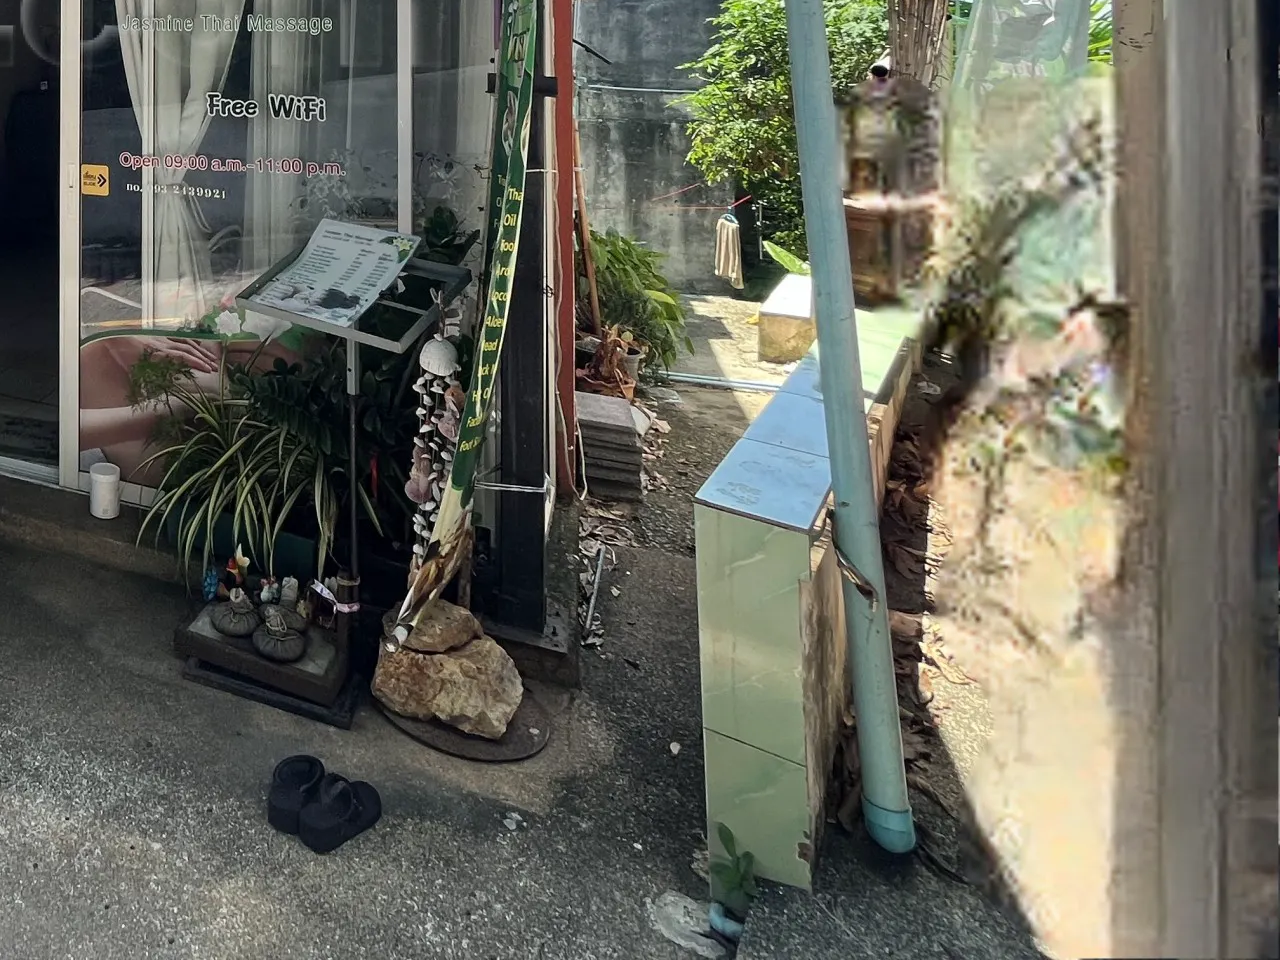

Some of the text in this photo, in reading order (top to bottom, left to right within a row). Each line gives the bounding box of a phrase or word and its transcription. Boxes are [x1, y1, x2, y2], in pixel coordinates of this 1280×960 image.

[121, 14, 333, 35] Jasmine Thai Massage
[206, 92, 326, 122] Free WiFi
[119, 152, 160, 170] Open
[164, 155, 208, 171] 09:00
[306, 161, 347, 178] p.m.
[503, 214, 517, 226] Oil
